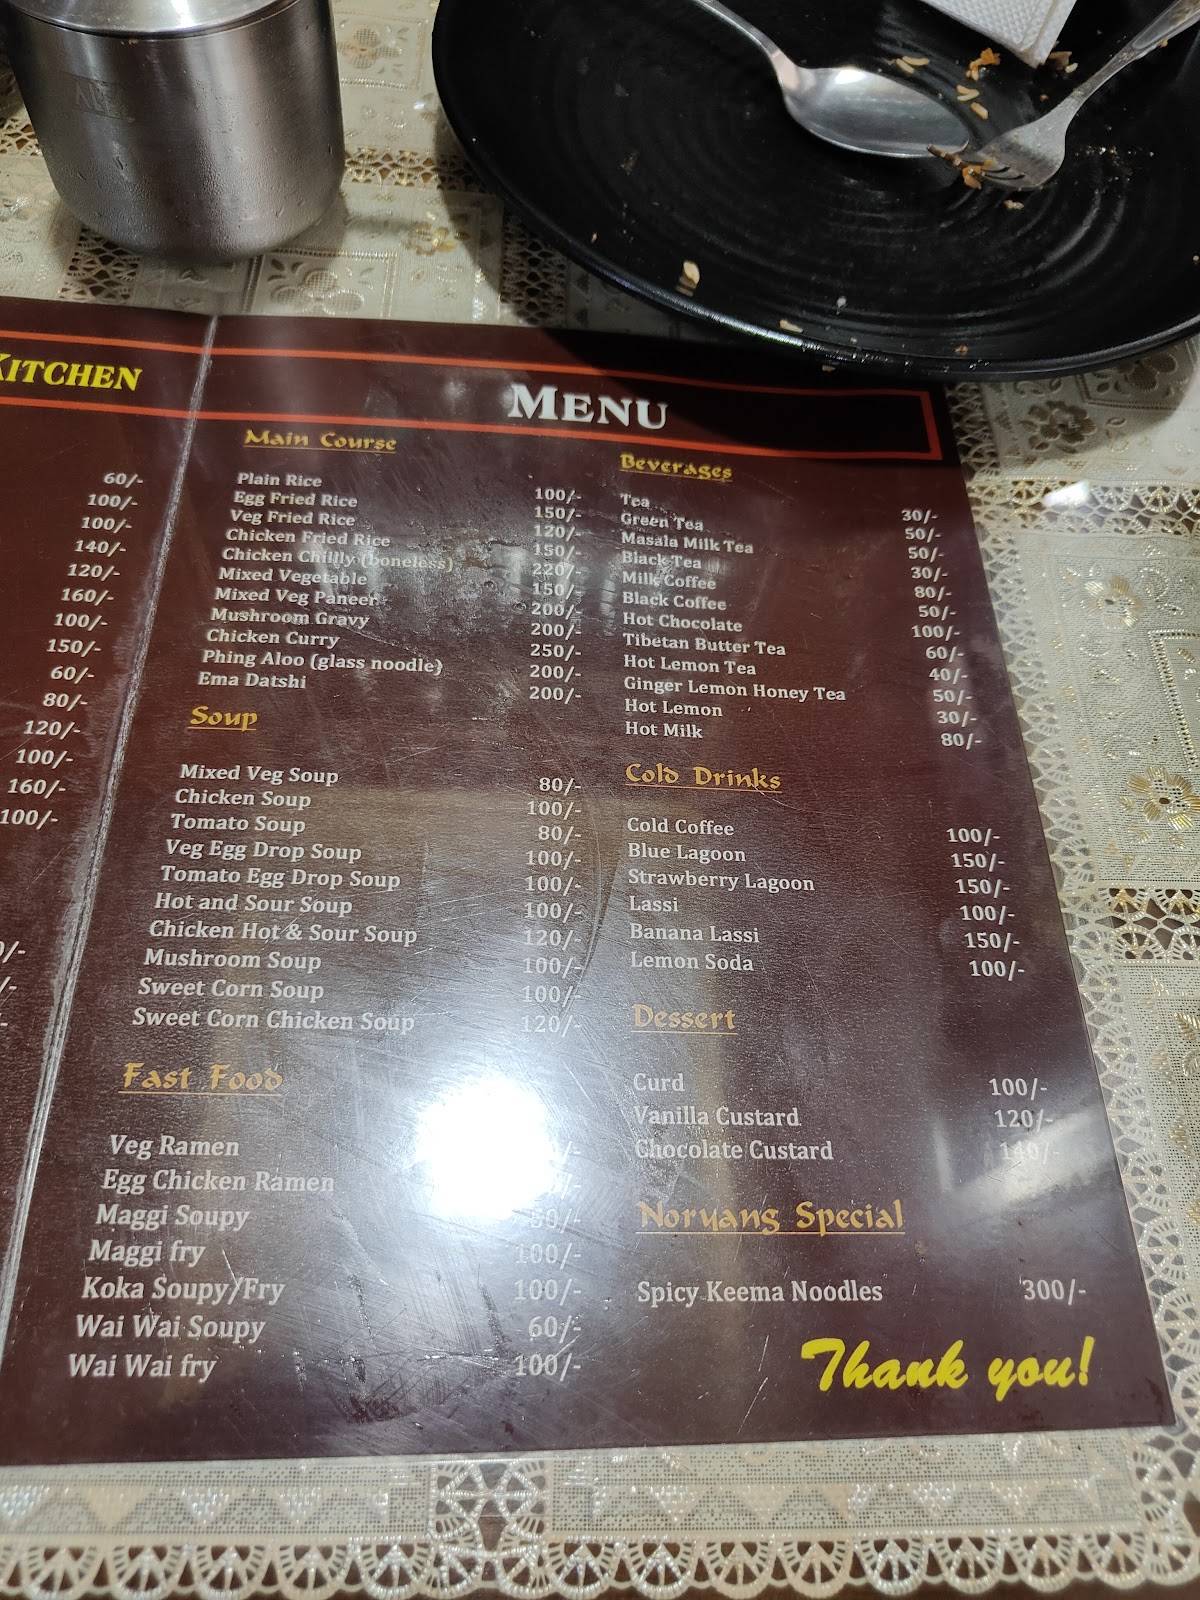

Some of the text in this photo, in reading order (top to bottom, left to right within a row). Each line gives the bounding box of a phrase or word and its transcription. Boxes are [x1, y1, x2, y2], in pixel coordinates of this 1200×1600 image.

[504, 385, 667, 429] MENU
[245, 430, 396, 453] Main Course
[620, 454, 731, 482] Beverages
[104, 473, 143, 488] 60/-
[238, 473, 322, 487] Plain Rice
[234, 491, 357, 507] Egg Fried Rice
[620, 493, 649, 507] Tea
[231, 510, 355, 525] Veg Fried Rice
[621, 513, 703, 531] Green Tea
[75, 540, 126, 557] 140/-
[226, 529, 390, 548] Chicken Fried Rice
[622, 532, 753, 553] Masala Milk Tea
[621, 550, 701, 568] Black Tea
[219, 567, 366, 585] Mixed Vegetable
[623, 571, 716, 589] Milk Coffee
[215, 588, 381, 606] Mixed Veg Paneer
[623, 592, 726, 610] Black Coffee
[211, 608, 369, 629] Mushroom Gravy
[624, 612, 742, 632] Hot Chocolate
[207, 629, 340, 649] Chicken Curry
[912, 625, 959, 641] 100/-
[531, 644, 581, 661] 250/-
[623, 633, 785, 655] Tibetan Butter Tea
[203, 650, 442, 675] Phing Aloo (glass noodle)
[624, 655, 756, 674] Hot Lemon Tea
[51, 666, 94, 684] 60/-
[198, 672, 306, 688] Ema Datshi
[929, 668, 967, 684] 40/-
[624, 677, 845, 702] Ginger Lemon Honey Tea
[43, 693, 87, 711] 80/-
[625, 699, 722, 716] Hot Lemon
[188, 706, 257, 731] Soup
[24, 721, 80, 739] 120/-
[626, 721, 702, 738] Hot Milk
[180, 764, 338, 786] Mixed Veg Soup
[626, 763, 782, 790] Cold Drinks
[540, 778, 581, 795] 80/-
[175, 789, 311, 810] Chicken Soup
[171, 814, 305, 836] Tomato Soup
[628, 818, 734, 835] Cold Coffee
[167, 839, 361, 863] Veg Egg Drop Soup
[628, 843, 746, 864] Blue Lagoon
[951, 853, 1004, 872] 150/-
[161, 866, 400, 892] Tomato Egg Drop Soup
[629, 869, 815, 893] Strawberry Lagoon
[155, 893, 352, 917] Hot and Sour Soup
[630, 896, 678, 911] Lassi
[150, 920, 417, 947] Chicken Hot & Sour Soup
[630, 923, 759, 942] Banana Lassi
[144, 948, 321, 973] Mushroom Soup
[631, 952, 754, 971] Lemon Soda
[138, 978, 323, 1003] Sweet Corn Soup
[133, 1007, 414, 1035] Sweet Corn Chicken Soup
[631, 1005, 735, 1033] Dessert
[123, 1063, 282, 1090] Fast Food
[634, 1073, 685, 1091] Curd
[989, 1078, 1047, 1100] 100/-
[634, 1106, 801, 1126] Vanilla Custard
[111, 1134, 238, 1160] Veg Ramen
[637, 1139, 834, 1160] Chocolate Custard
[101, 1169, 333, 1194] Egg Chicken Ramen
[96, 1204, 250, 1231] Maggi Soupy
[796, 1200, 905, 1236] Special
[88, 1240, 206, 1267] Maggi fry
[82, 1276, 284, 1305] Koka Soupy/Fry
[638, 1280, 882, 1308] Spicy Keema Noodles
[1023, 1279, 1086, 1305] 300/-
[77, 1315, 265, 1344] Wai Wai Soupy
[70, 1354, 216, 1383] Wai Wai fry
[801, 1336, 1094, 1401] Thank you!
